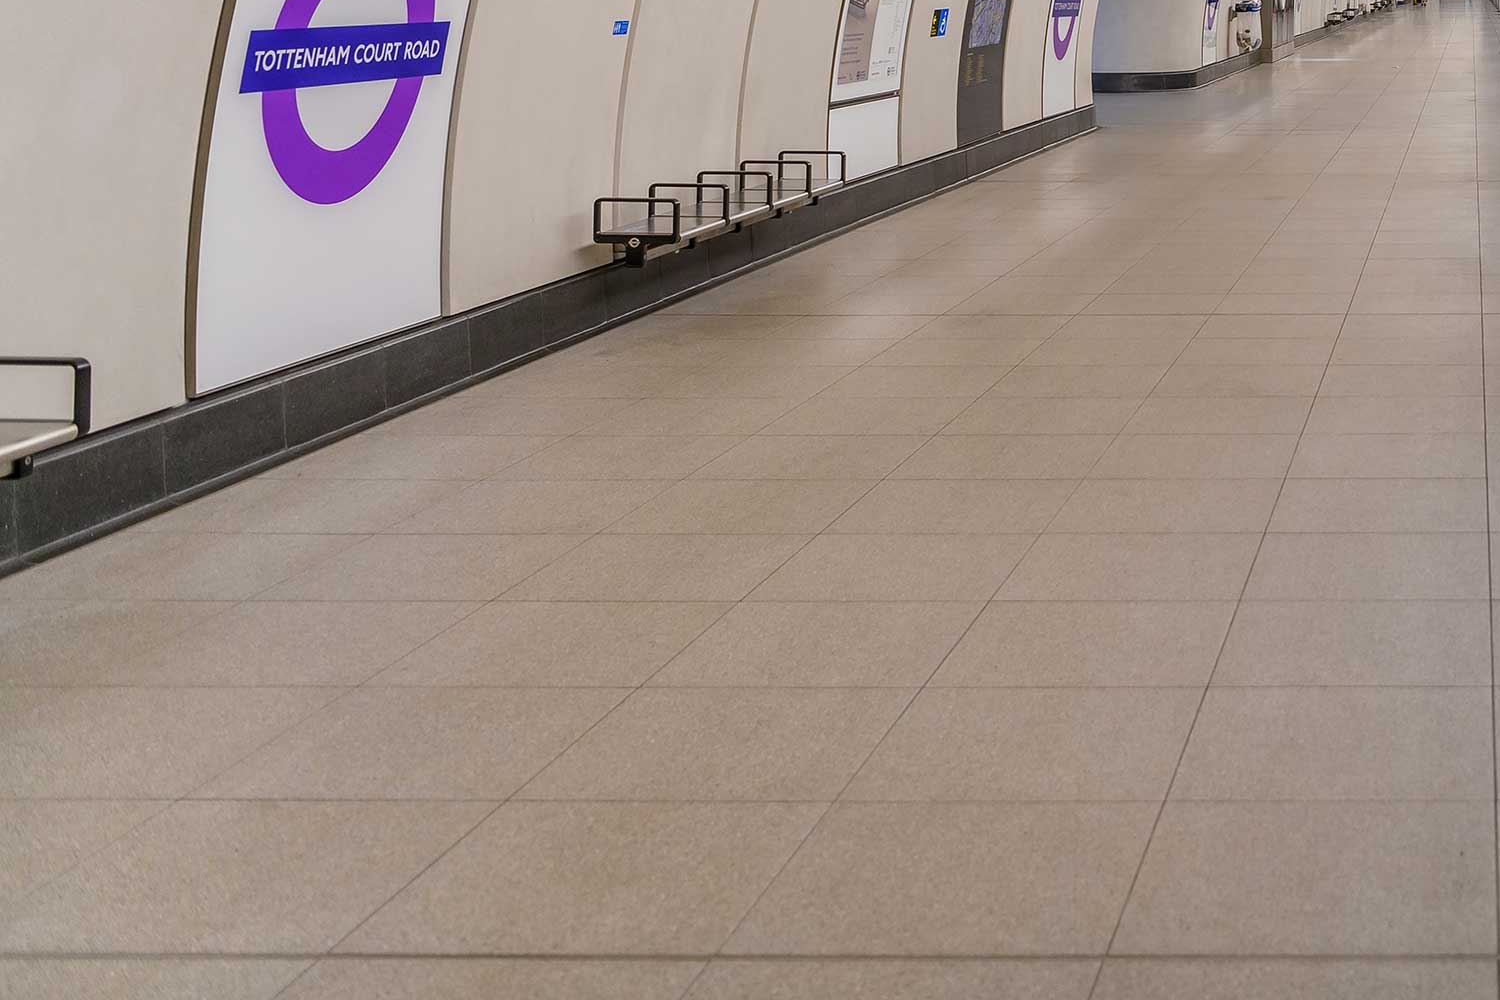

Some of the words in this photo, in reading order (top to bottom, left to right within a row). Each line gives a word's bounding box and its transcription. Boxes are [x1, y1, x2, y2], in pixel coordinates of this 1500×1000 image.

[254, 45, 351, 72] TOTTENHAM
[353, 42, 402, 64] COURT
[404, 39, 440, 61] ROAD
